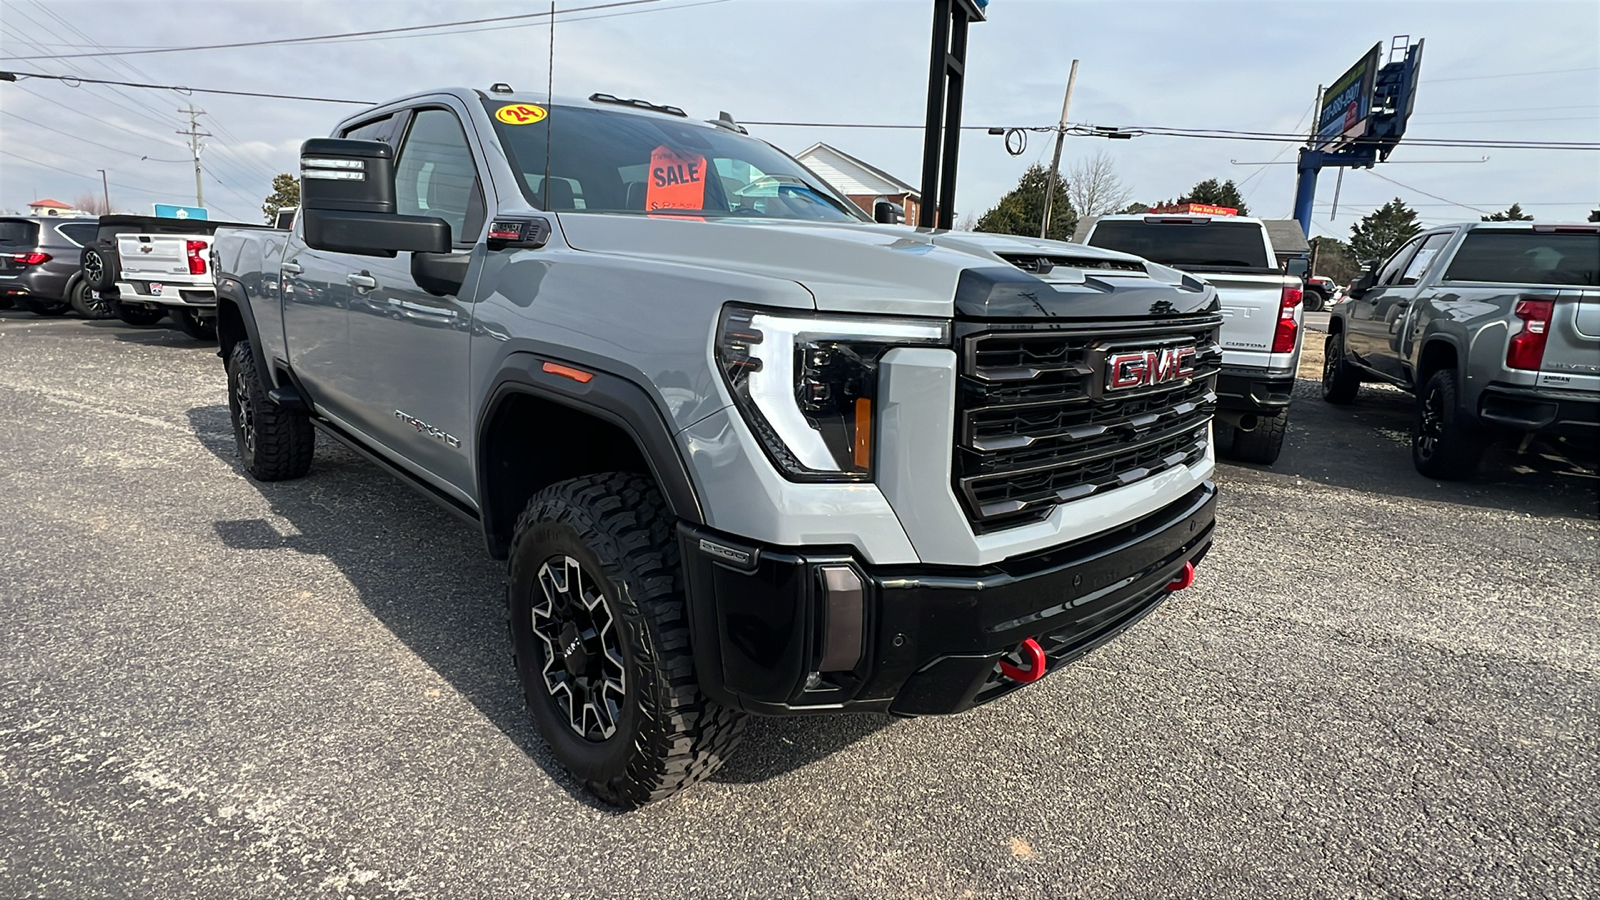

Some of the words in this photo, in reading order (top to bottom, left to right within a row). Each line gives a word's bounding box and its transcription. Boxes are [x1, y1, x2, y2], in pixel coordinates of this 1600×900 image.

[506, 106, 540, 122] 24
[653, 162, 700, 188] SALE
[1110, 347, 1196, 391] GMC
